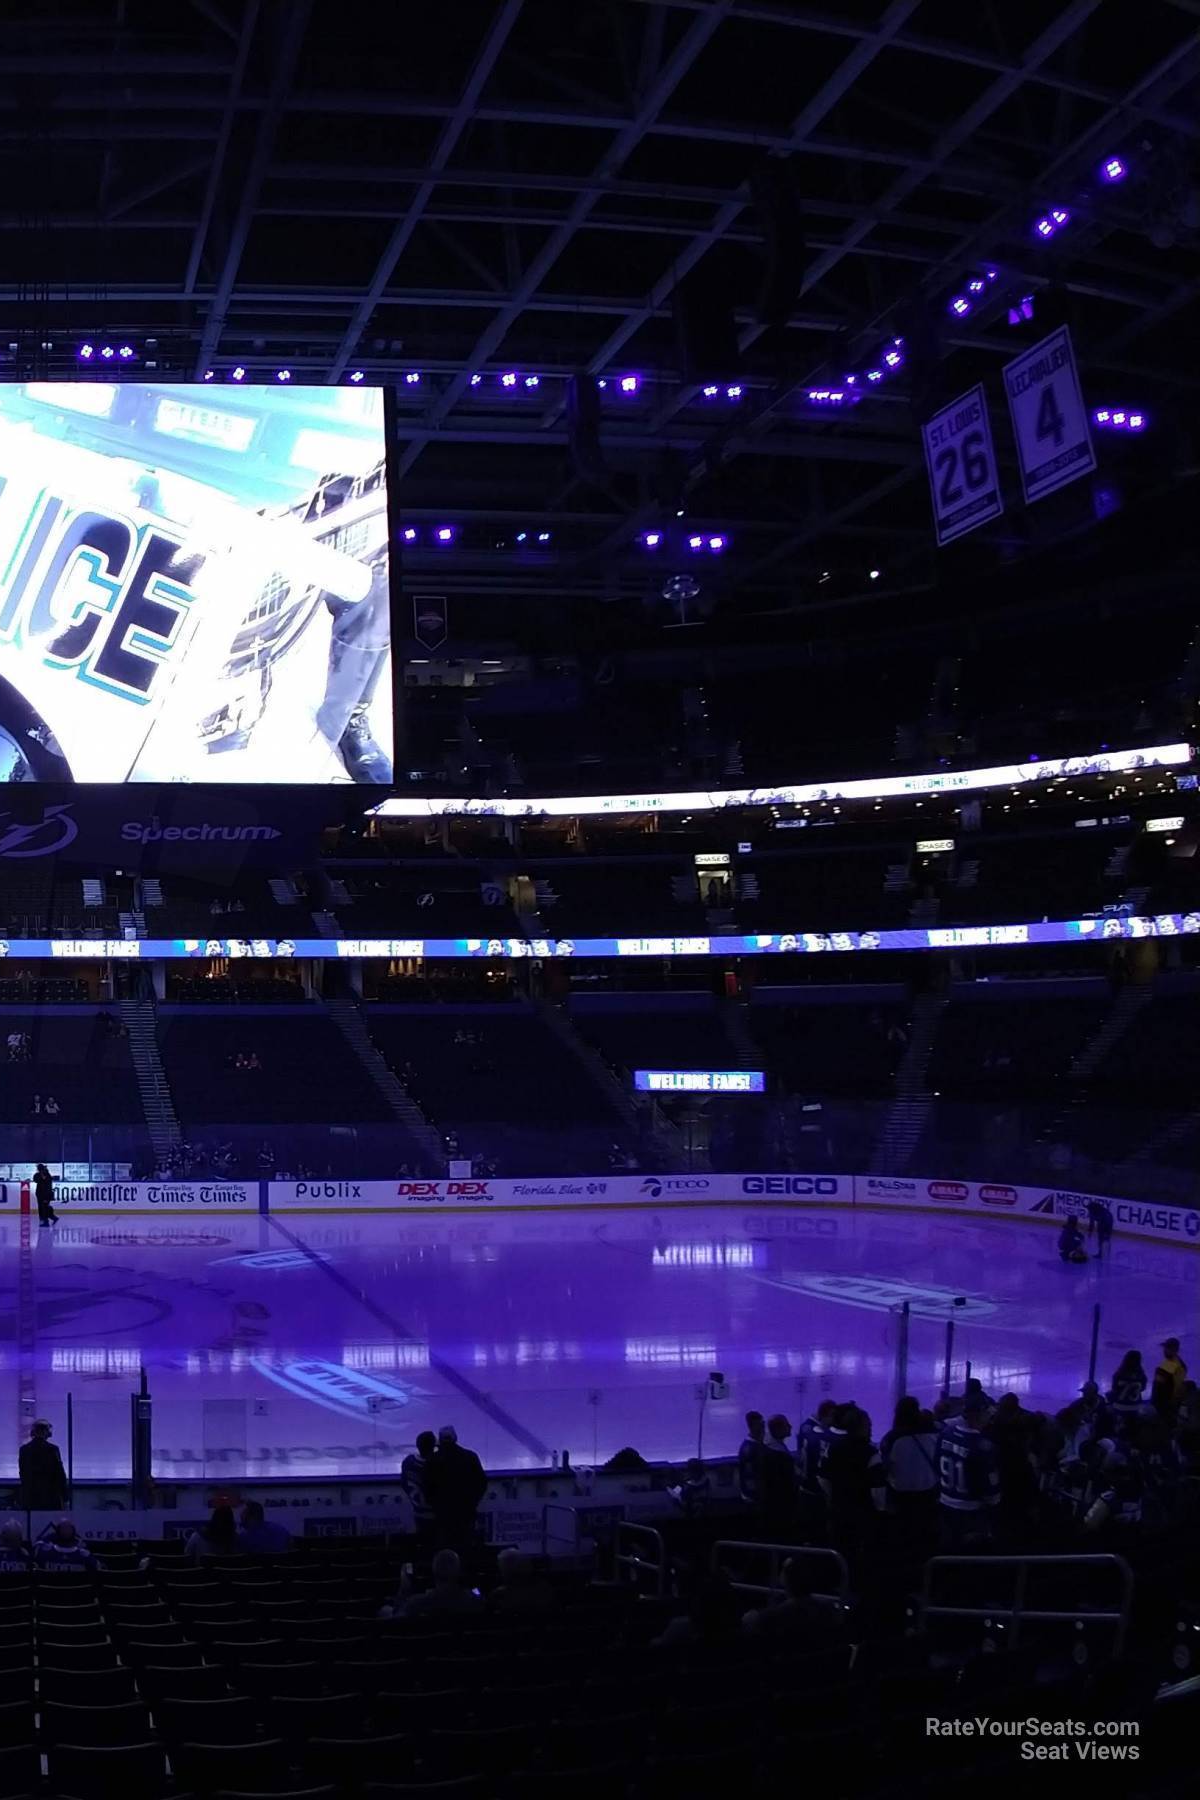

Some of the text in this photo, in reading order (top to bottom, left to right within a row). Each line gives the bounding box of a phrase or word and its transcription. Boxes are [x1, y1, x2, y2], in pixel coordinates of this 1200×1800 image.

[949, 401, 981, 437] LOUIS
[1036, 382, 1065, 448] 4
[935, 431, 988, 509] 26
[120, 821, 273, 846] Spectrum
[648, 1073, 710, 1090] WELCOME
[296, 1182, 362, 1198] Publix
[397, 1182, 441, 1195] DEX
[446, 1182, 489, 1195] DEX
[512, 1184, 557, 1195] Florida
[665, 1179, 709, 1189] TECO
[742, 1176, 837, 1195] GEICO
[51, 1183, 138, 1204] ägermeister
[147, 1186, 195, 1203] Times
[199, 1186, 248, 1203] Times
[1116, 1204, 1181, 1232] CHASE
[937, 1455, 969, 1494] 91
